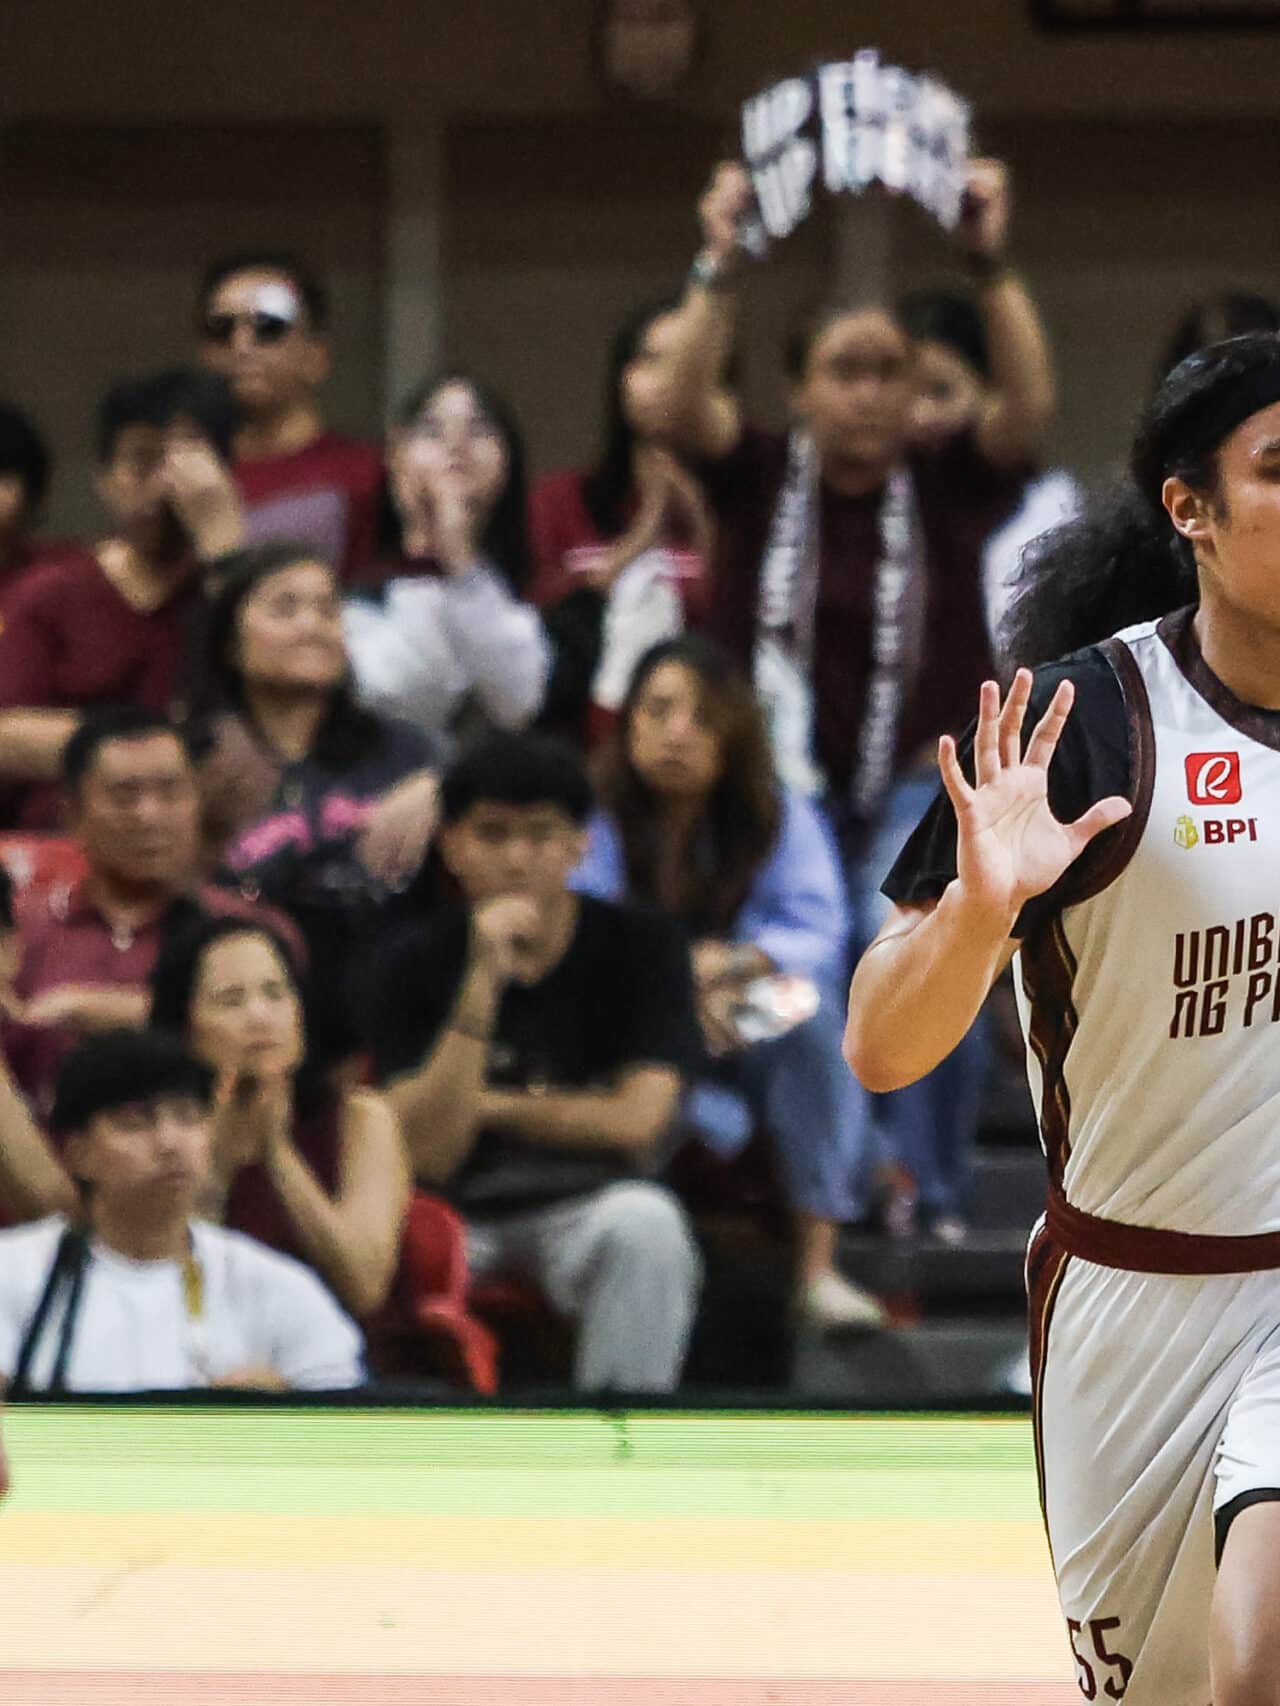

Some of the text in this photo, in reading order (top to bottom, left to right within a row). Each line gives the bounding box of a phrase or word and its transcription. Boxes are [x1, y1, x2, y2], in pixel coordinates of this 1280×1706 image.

[1204, 818, 1257, 844] BPI
[1169, 979, 1229, 1039] NG
[1067, 1616, 1133, 1701] 55
